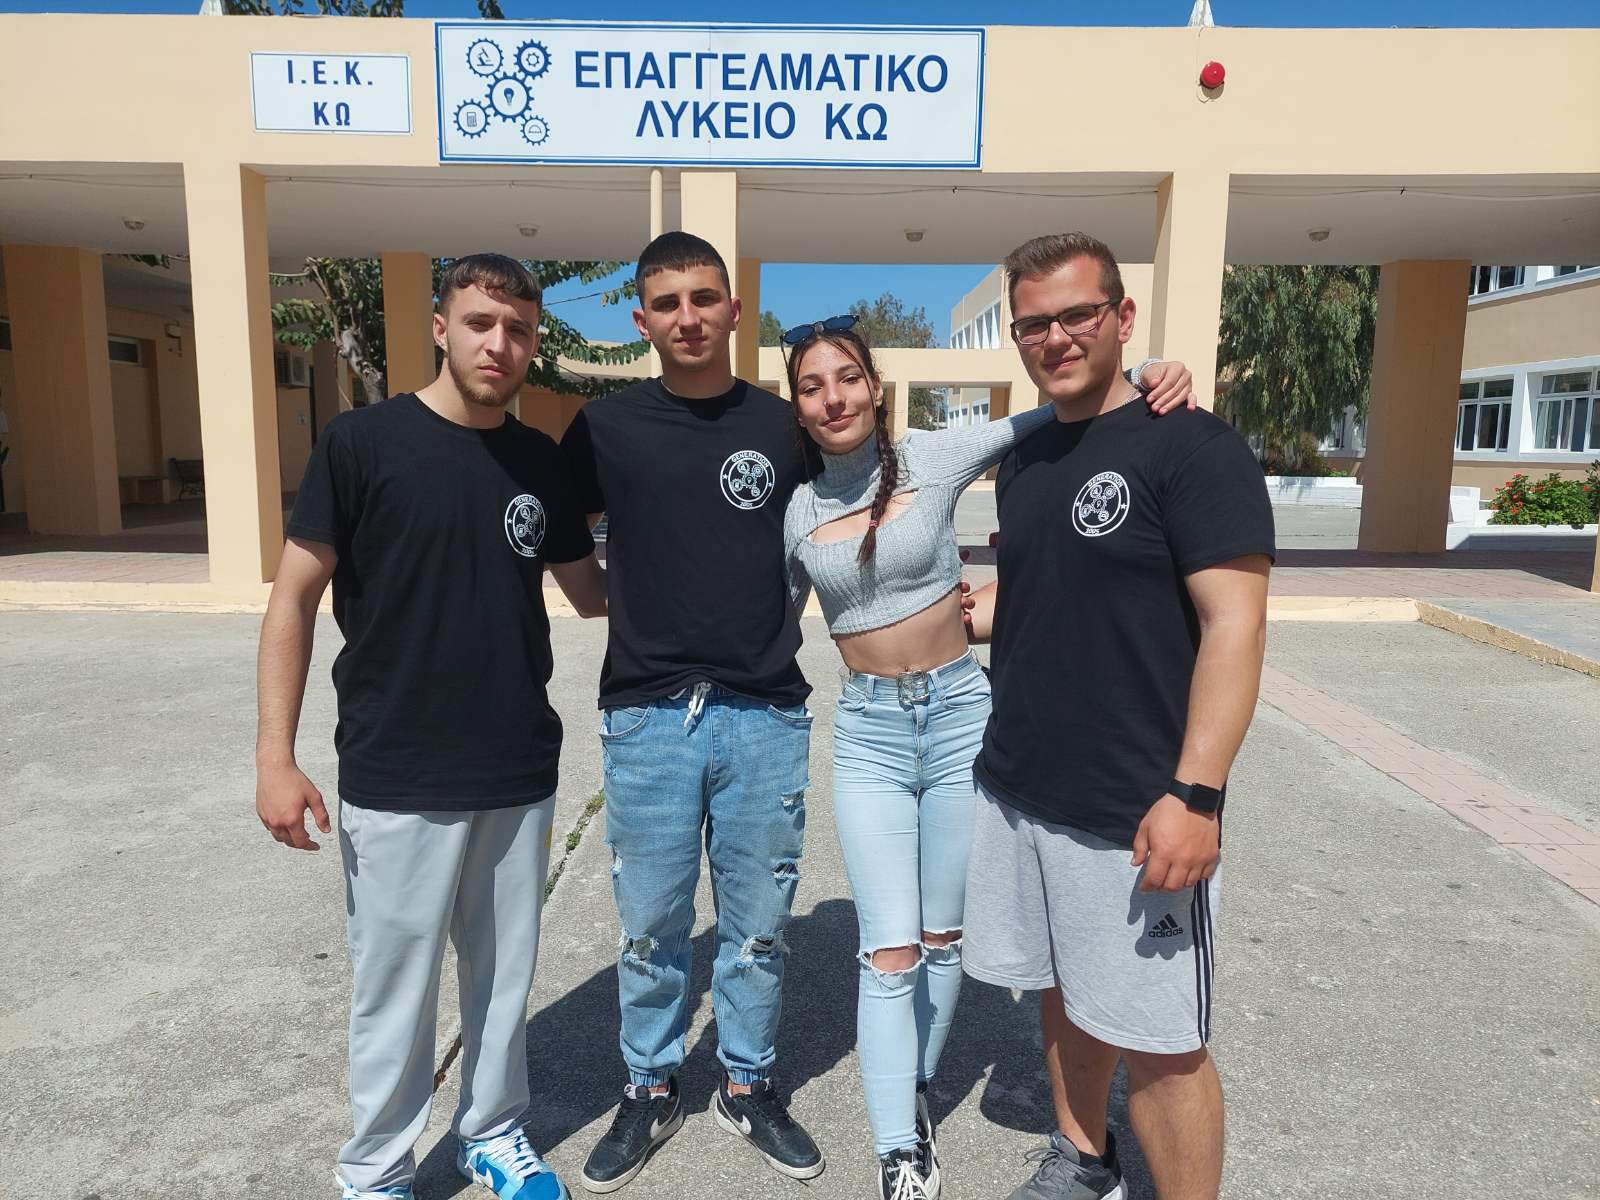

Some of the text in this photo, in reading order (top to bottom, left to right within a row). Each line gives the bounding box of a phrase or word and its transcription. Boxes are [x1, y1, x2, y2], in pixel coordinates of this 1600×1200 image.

[288, 60, 373, 85] Ι.Ε.Κ.
[575, 51, 949, 93] ΕΠΑΓΓΕΛΜΑΤΙΚΟ
[314, 102, 351, 126] ΚΩ
[636, 100, 888, 140] ΛΥΚΕΙΟ ΚΩ
[731, 452, 770, 468] GENERATION
[1148, 928, 1183, 937] adidas
